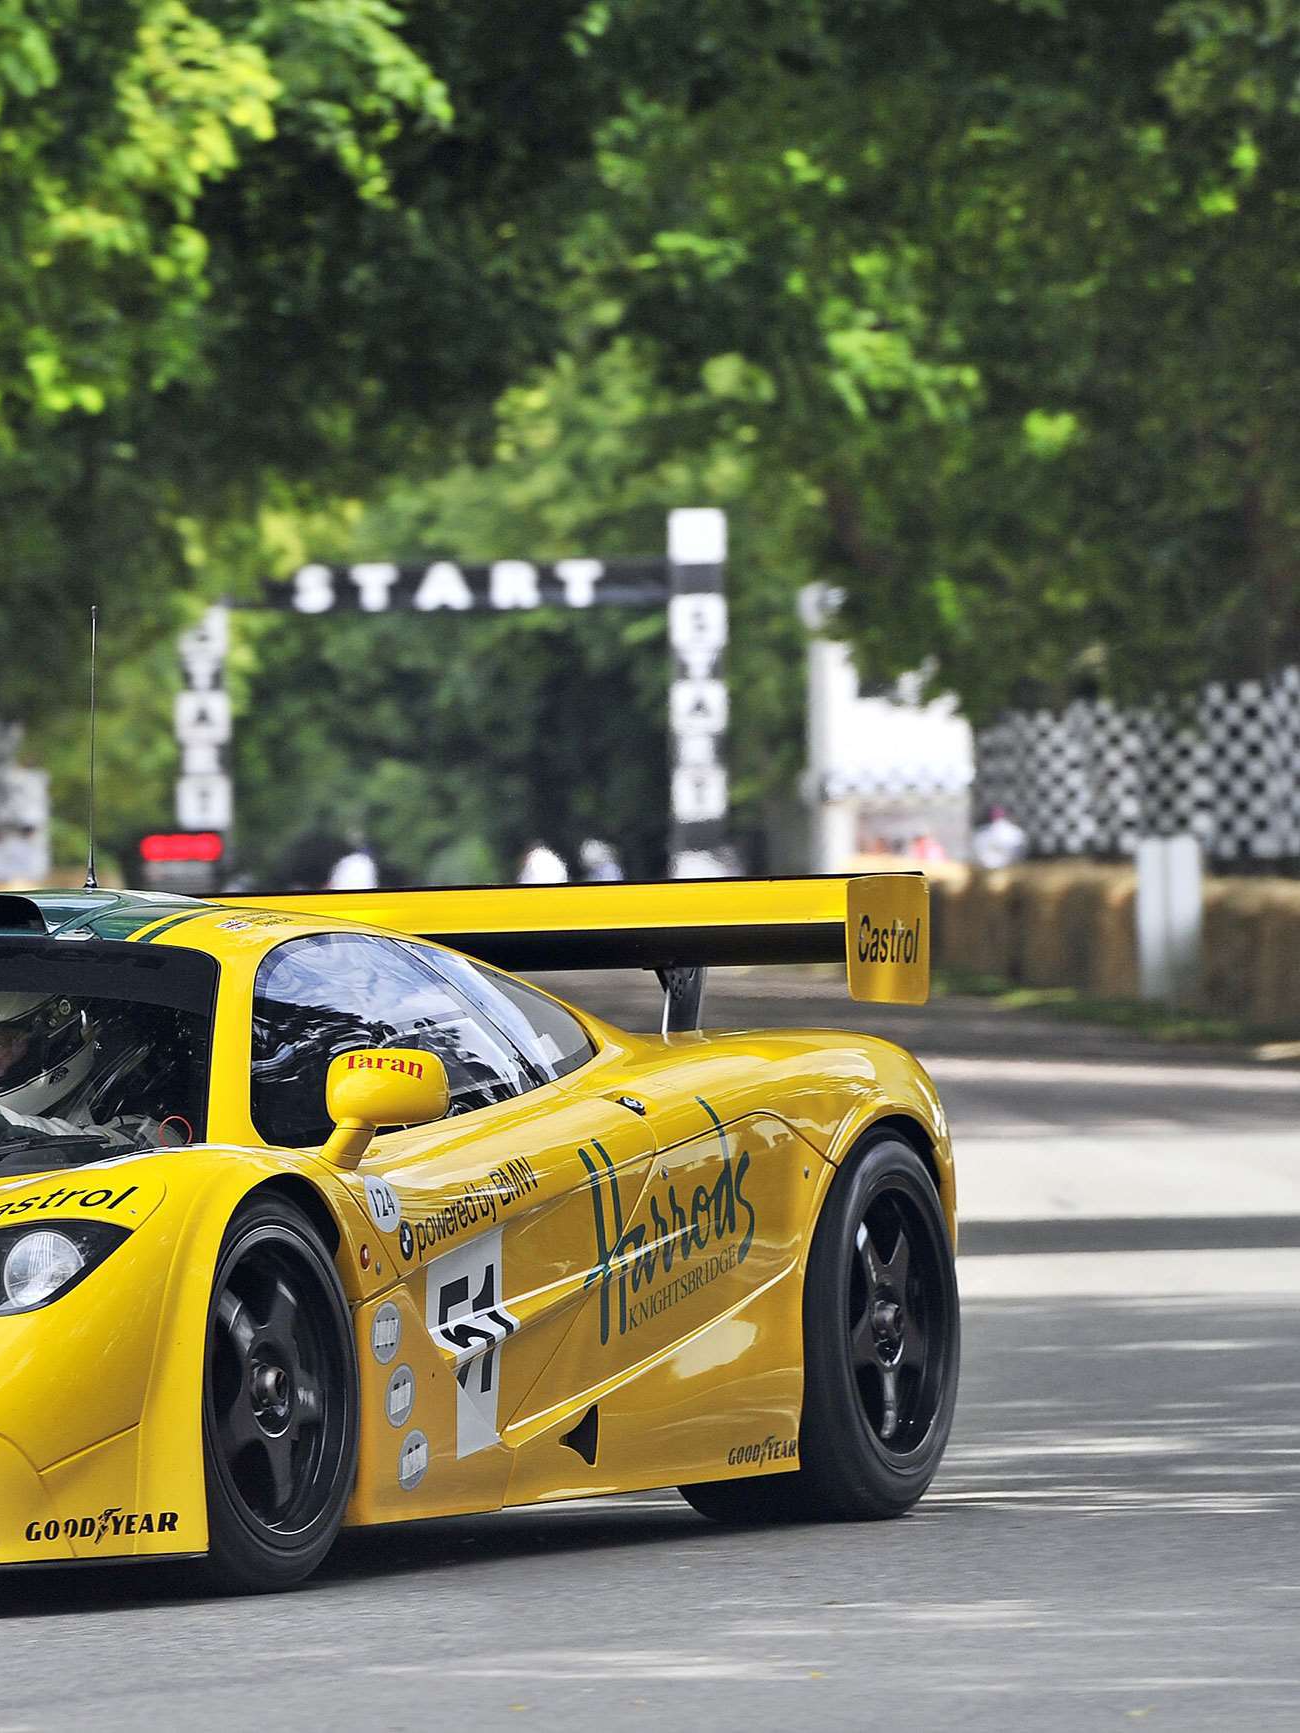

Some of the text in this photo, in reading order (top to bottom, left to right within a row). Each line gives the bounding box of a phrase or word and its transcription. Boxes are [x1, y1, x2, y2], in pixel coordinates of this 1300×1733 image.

[292, 559, 604, 614] START
[858, 914, 920, 964] Castrol
[341, 1053, 425, 1081] Taran
[369, 1187, 397, 1219] 124
[414, 1155, 539, 1262] powered by BMW
[576, 1096, 755, 1346] Harrods
[628, 1244, 737, 1331] KNIGHTSBRIDGE
[438, 1263, 515, 1393] 51
